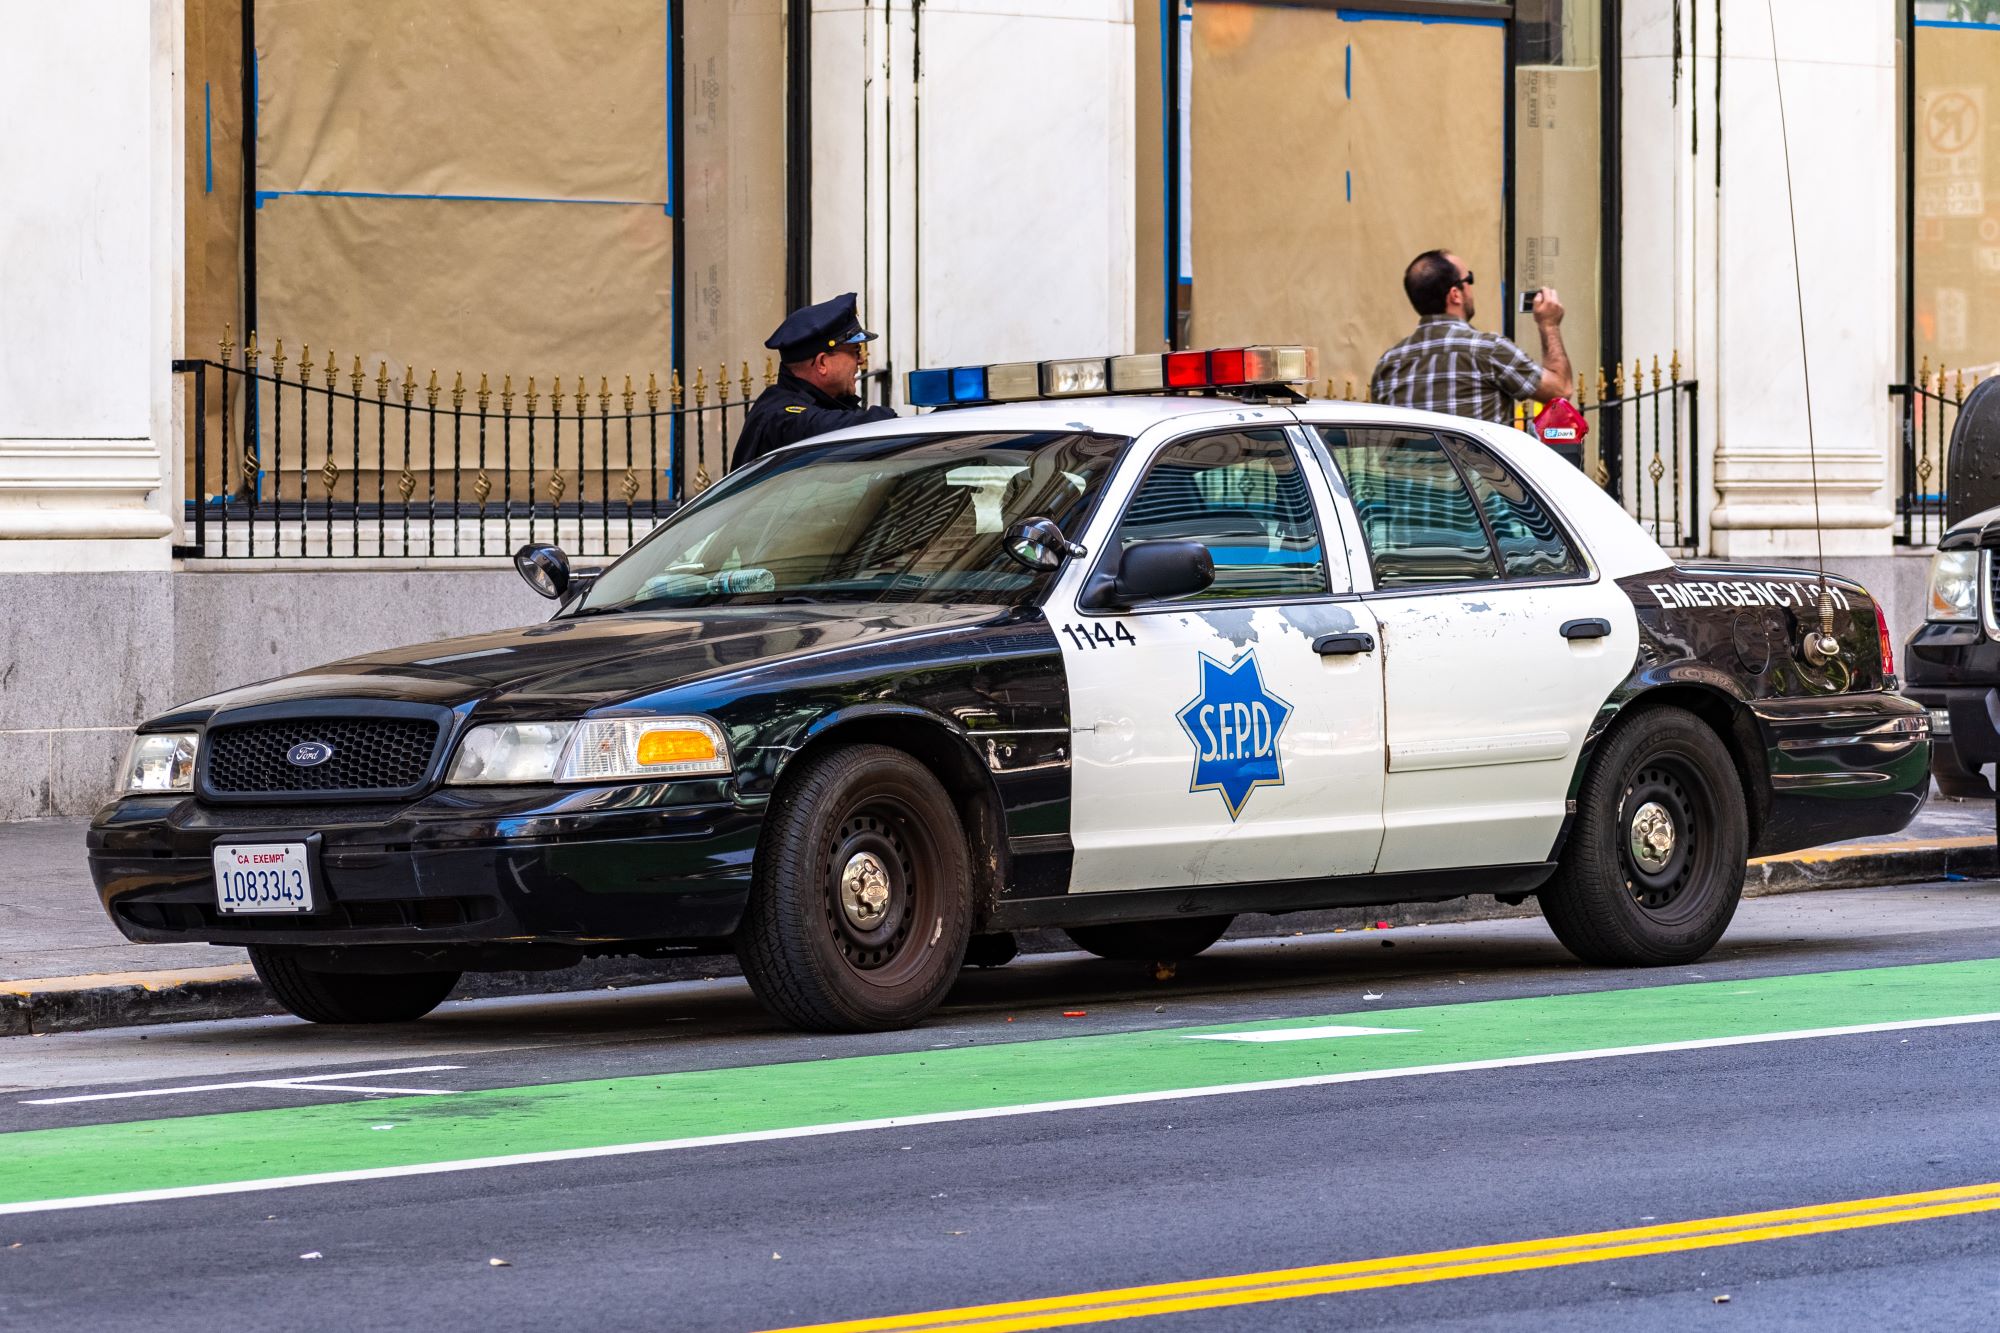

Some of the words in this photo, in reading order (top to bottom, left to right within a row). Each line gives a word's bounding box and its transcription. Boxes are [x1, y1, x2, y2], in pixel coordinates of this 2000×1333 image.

[1647, 581, 1803, 609] EMERGENCY
[1061, 620, 1136, 650] 1144
[1199, 701, 1273, 763] S.F.P.D.
[296, 746, 320, 760] Ford
[237, 854, 250, 864] CA
[253, 853, 285, 864] EXEMPT
[223, 869, 304, 903] 1083343
